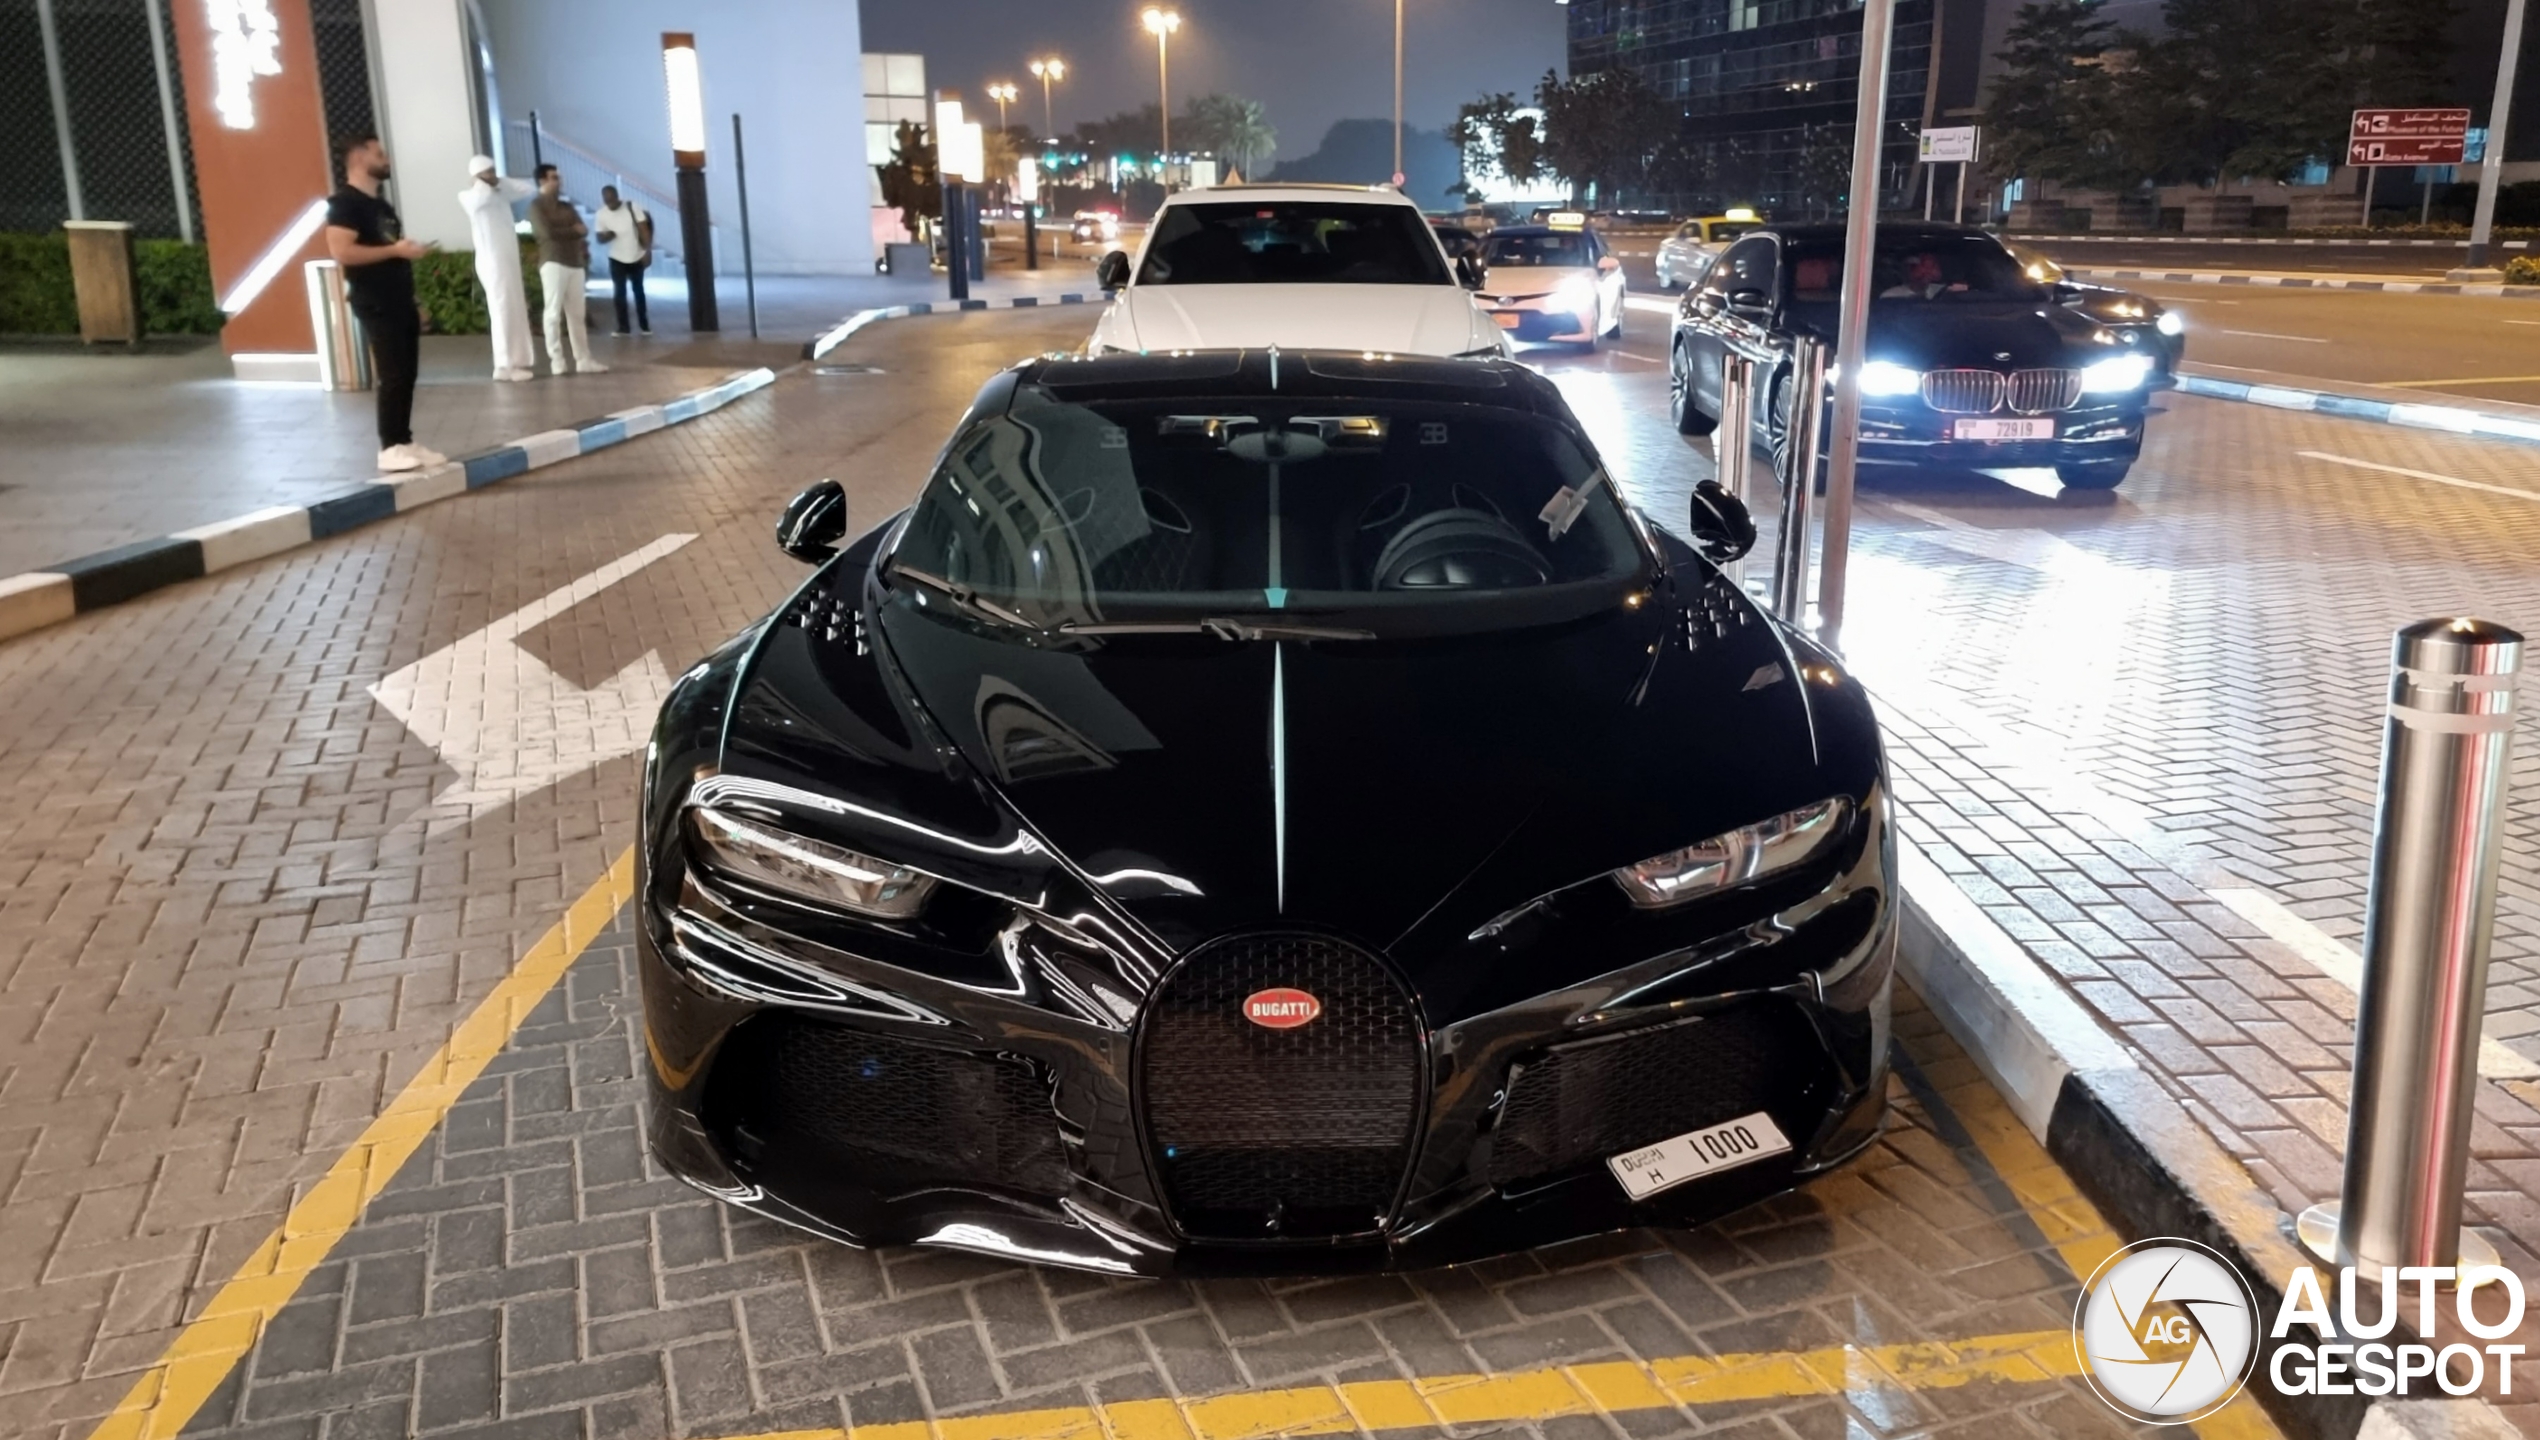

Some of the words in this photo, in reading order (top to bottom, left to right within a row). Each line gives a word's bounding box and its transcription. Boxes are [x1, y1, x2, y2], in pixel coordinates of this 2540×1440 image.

[1996, 422, 2034, 437] 72919
[1252, 1002, 1311, 1017] BUGATTI
[1688, 1125, 1759, 1164] 1000
[1646, 1168, 1666, 1185] H
